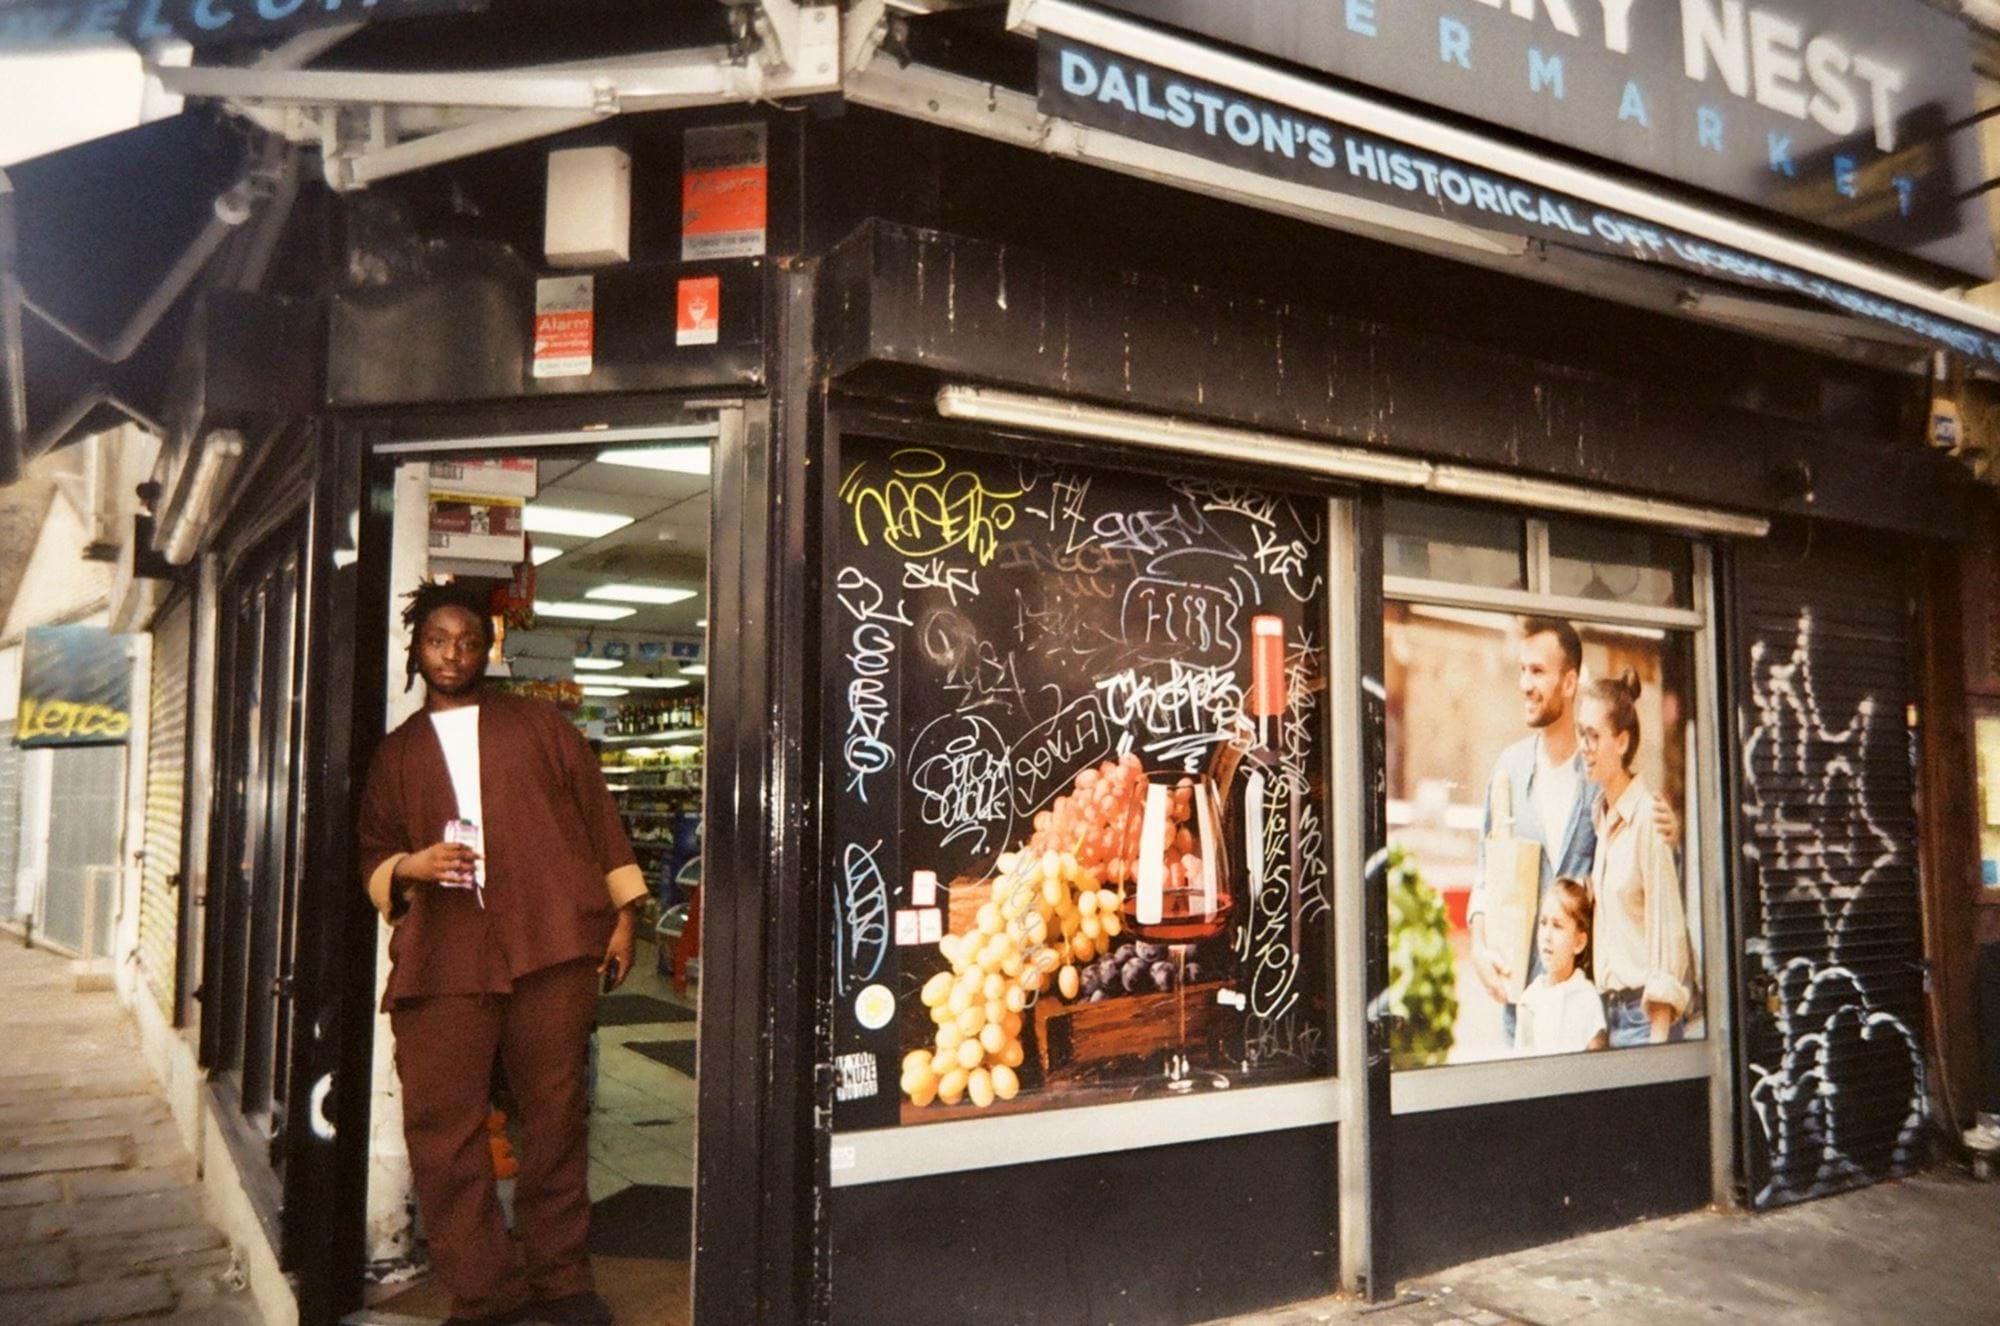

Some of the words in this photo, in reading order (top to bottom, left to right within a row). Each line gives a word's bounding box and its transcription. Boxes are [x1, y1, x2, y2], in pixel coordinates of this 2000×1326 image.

[1061, 49, 1336, 168] DALSTON'S
[1346, 141, 1591, 237] HISTORICAL
[1593, 214, 1664, 253] OFF
[1682, 0, 1911, 153] NEST
[540, 317, 590, 332] Alarm
